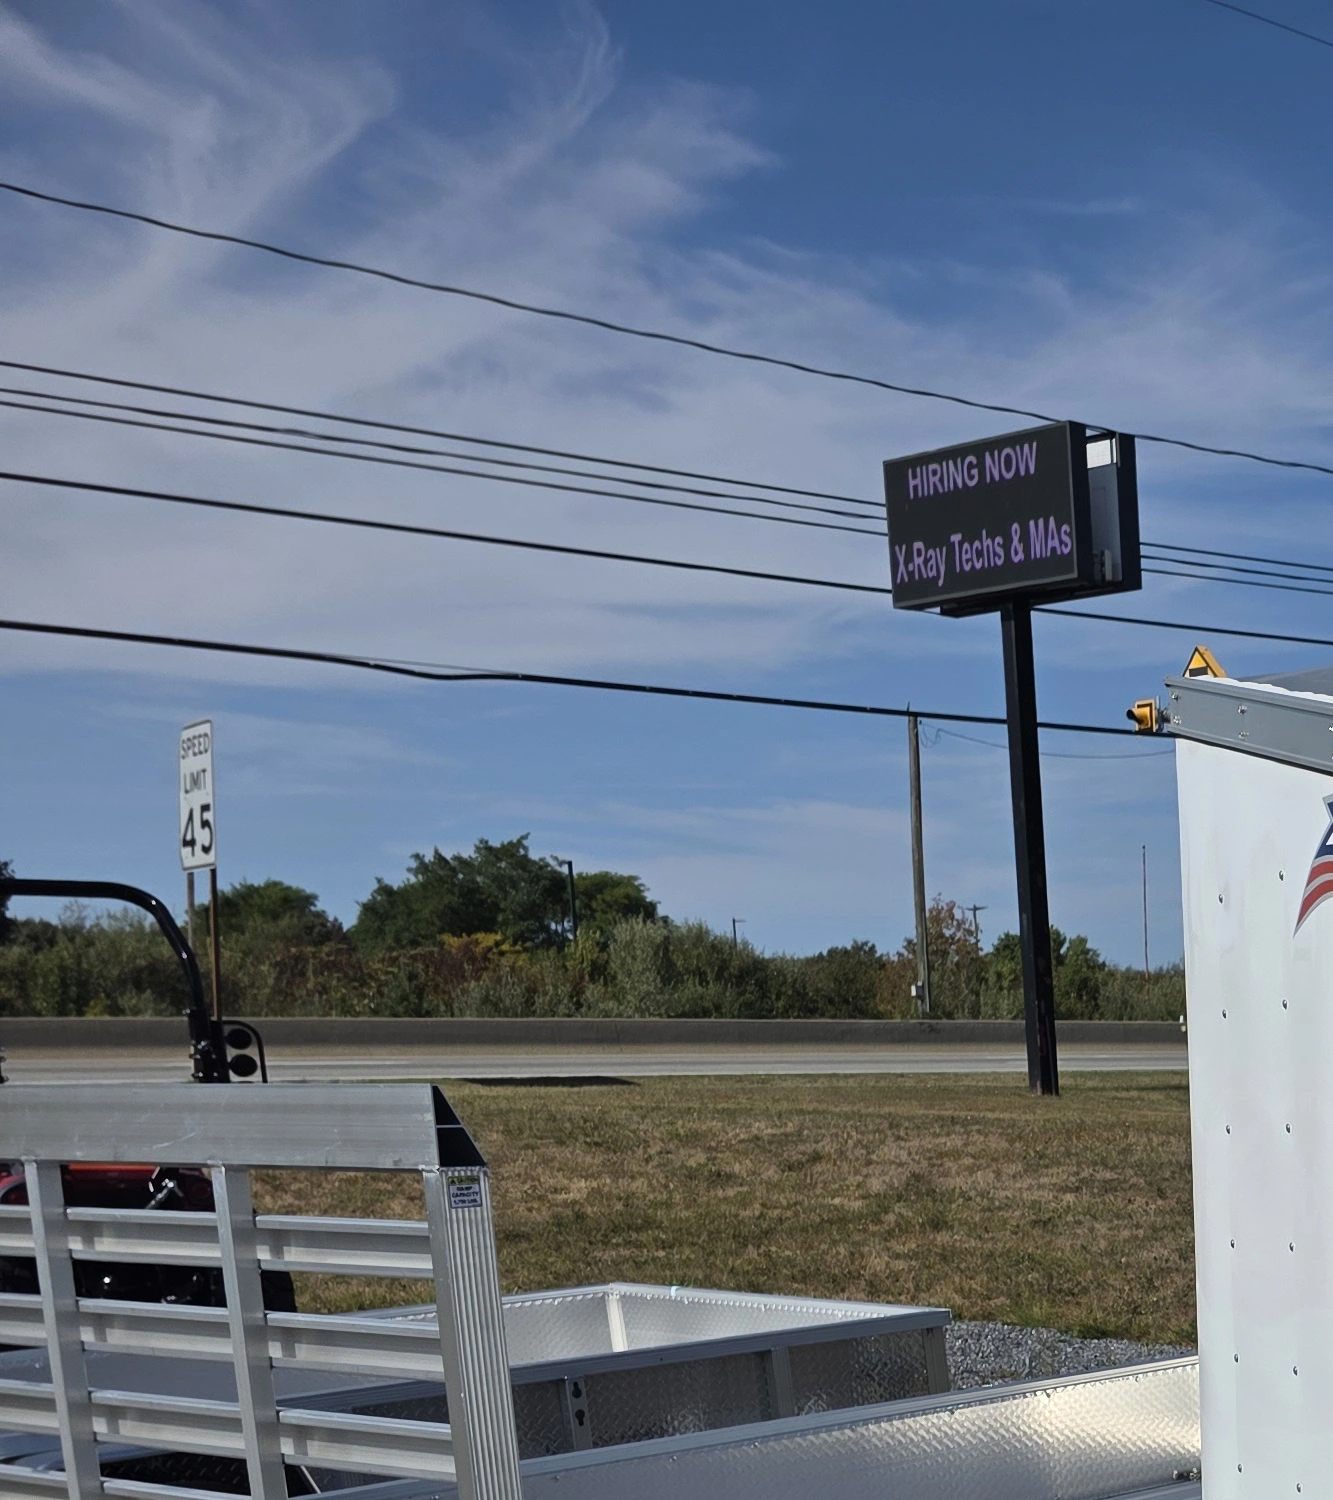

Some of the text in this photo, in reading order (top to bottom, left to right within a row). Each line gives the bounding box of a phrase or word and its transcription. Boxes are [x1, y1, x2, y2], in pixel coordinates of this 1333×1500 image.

[908, 441, 1037, 499] HIRING NOW
[894, 516, 1072, 587] X-Ray Techs & MAs
[181, 732, 210, 760] SPEED
[183, 768, 207, 794] LIMIT
[182, 804, 213, 857] 45
